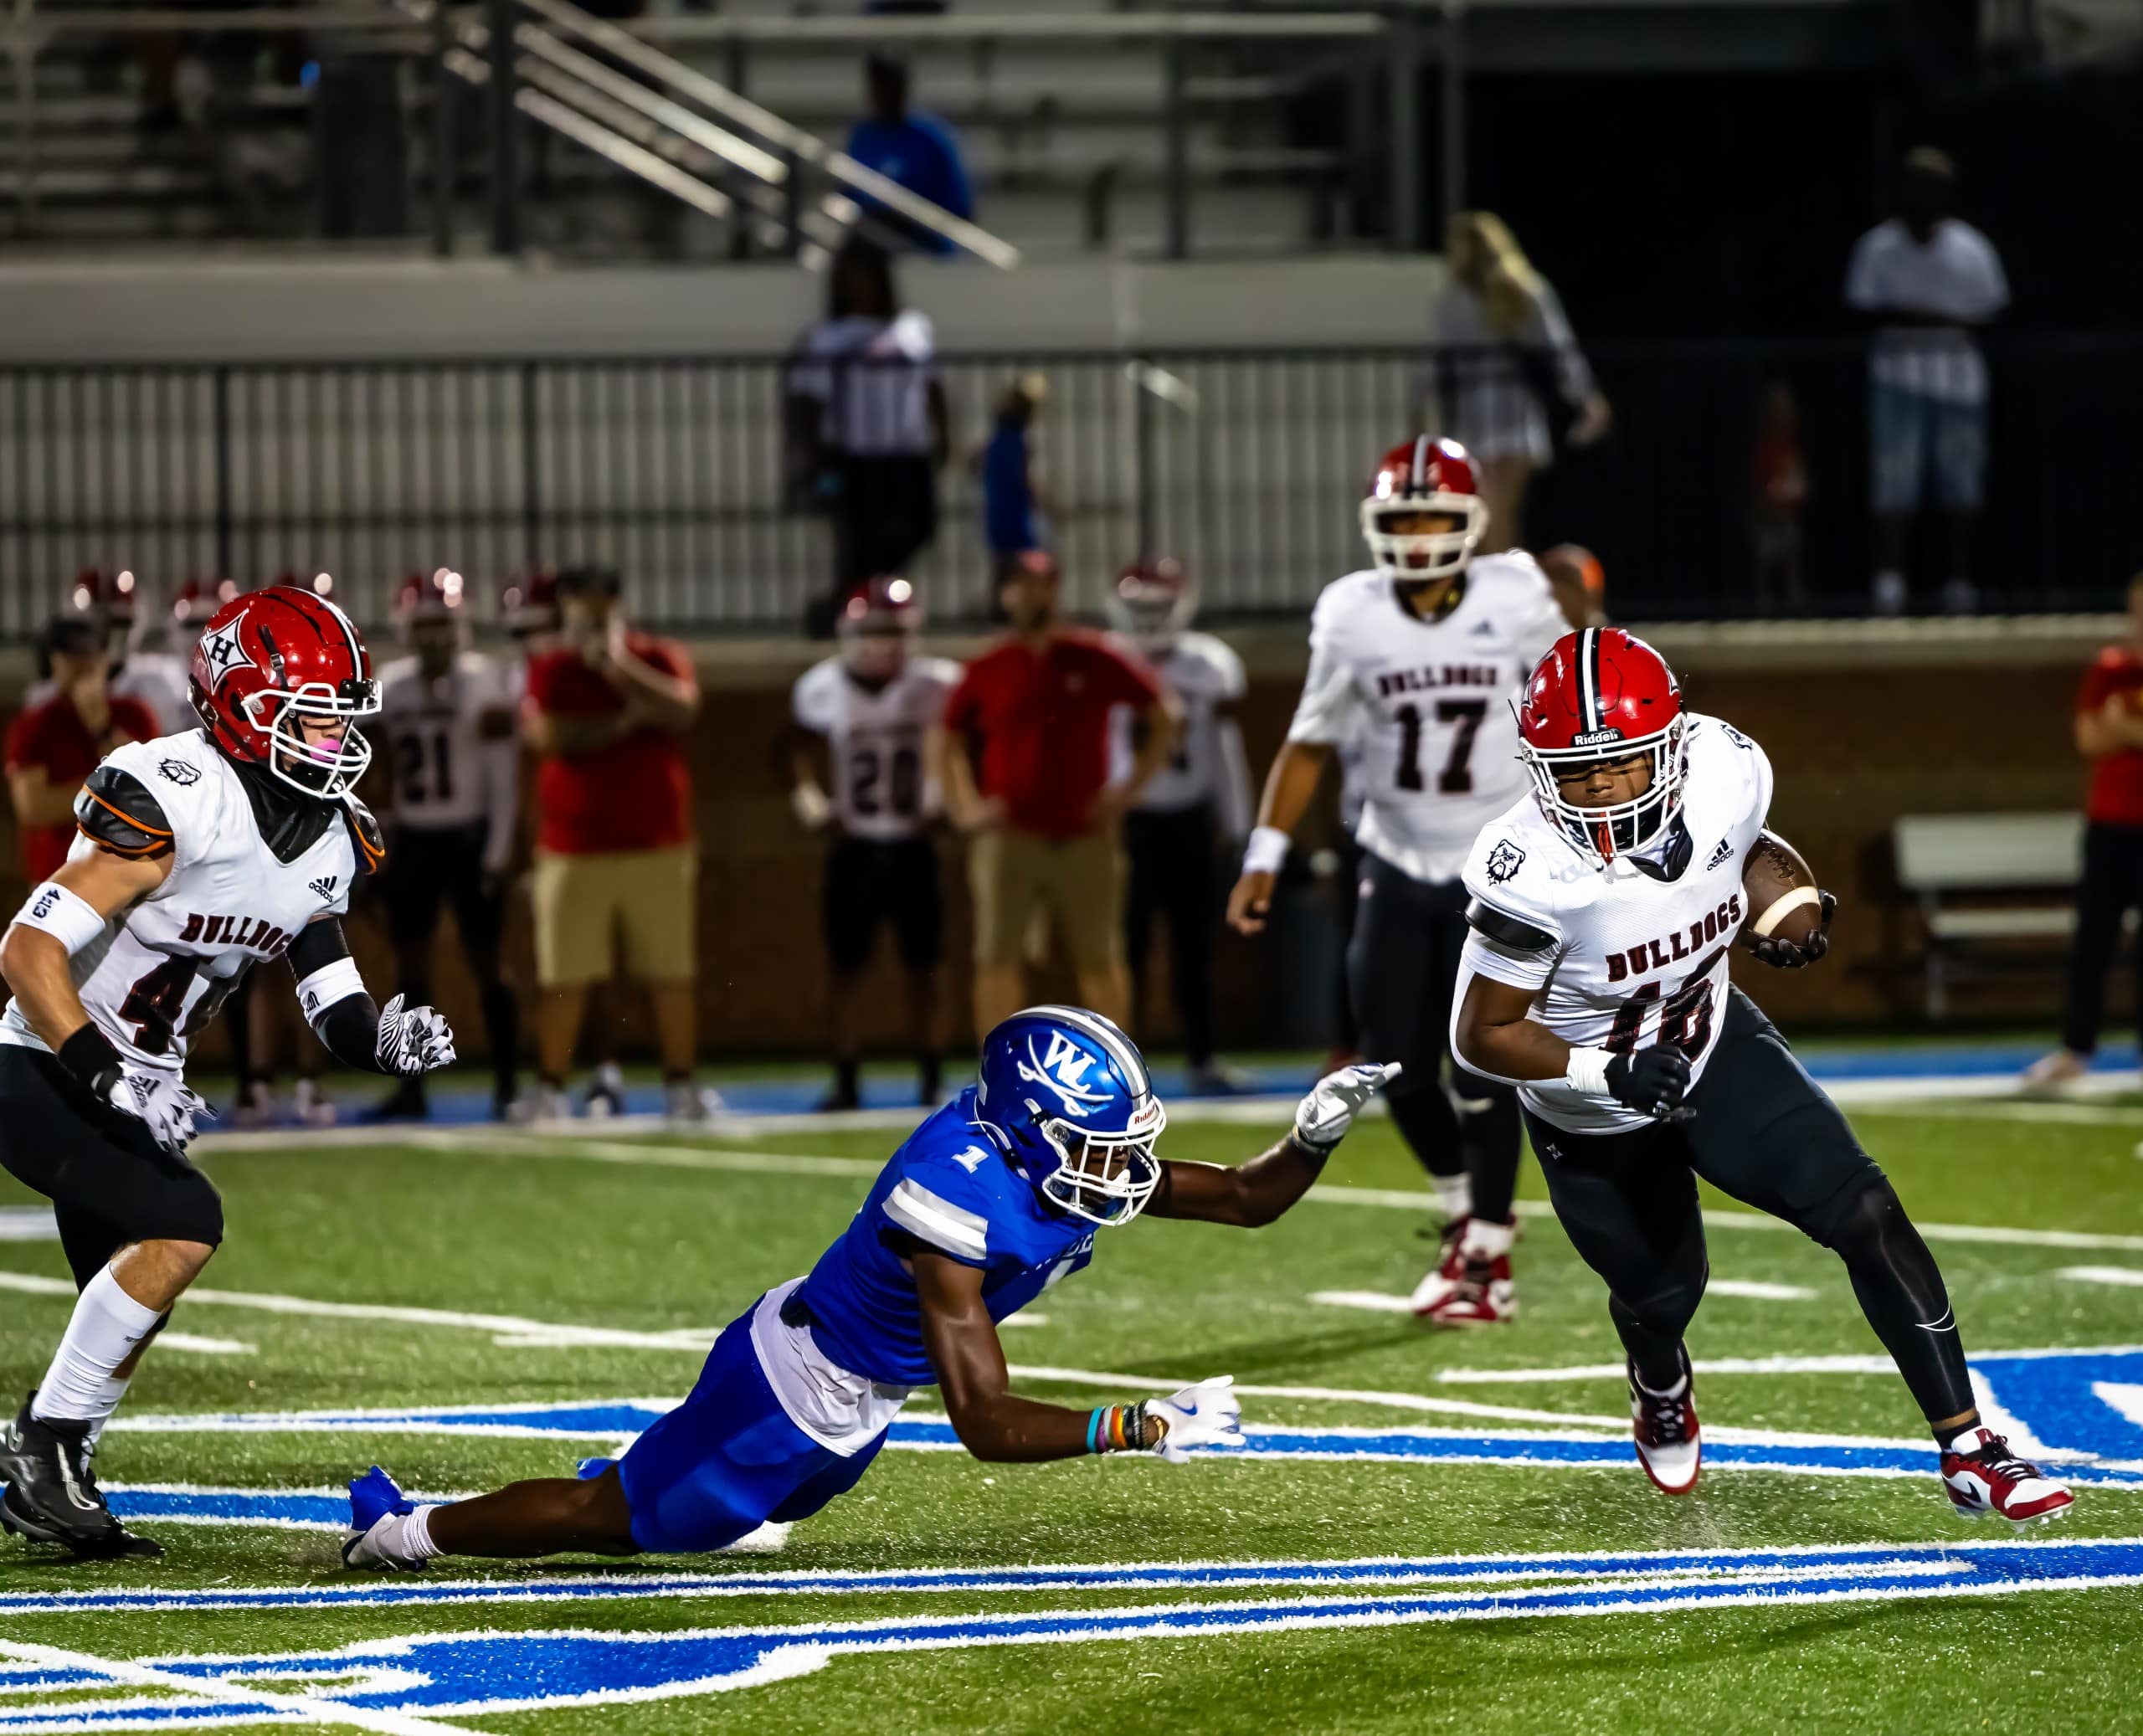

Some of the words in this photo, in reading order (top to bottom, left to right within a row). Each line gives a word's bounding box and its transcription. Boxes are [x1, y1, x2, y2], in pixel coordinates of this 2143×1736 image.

[210, 636, 235, 665] H
[399, 732, 453, 803] 21
[1393, 698, 1488, 794] 17
[1707, 849, 1734, 871] adidas
[1606, 893, 1741, 983] BULLDOGS
[951, 1145, 989, 1174] 1
